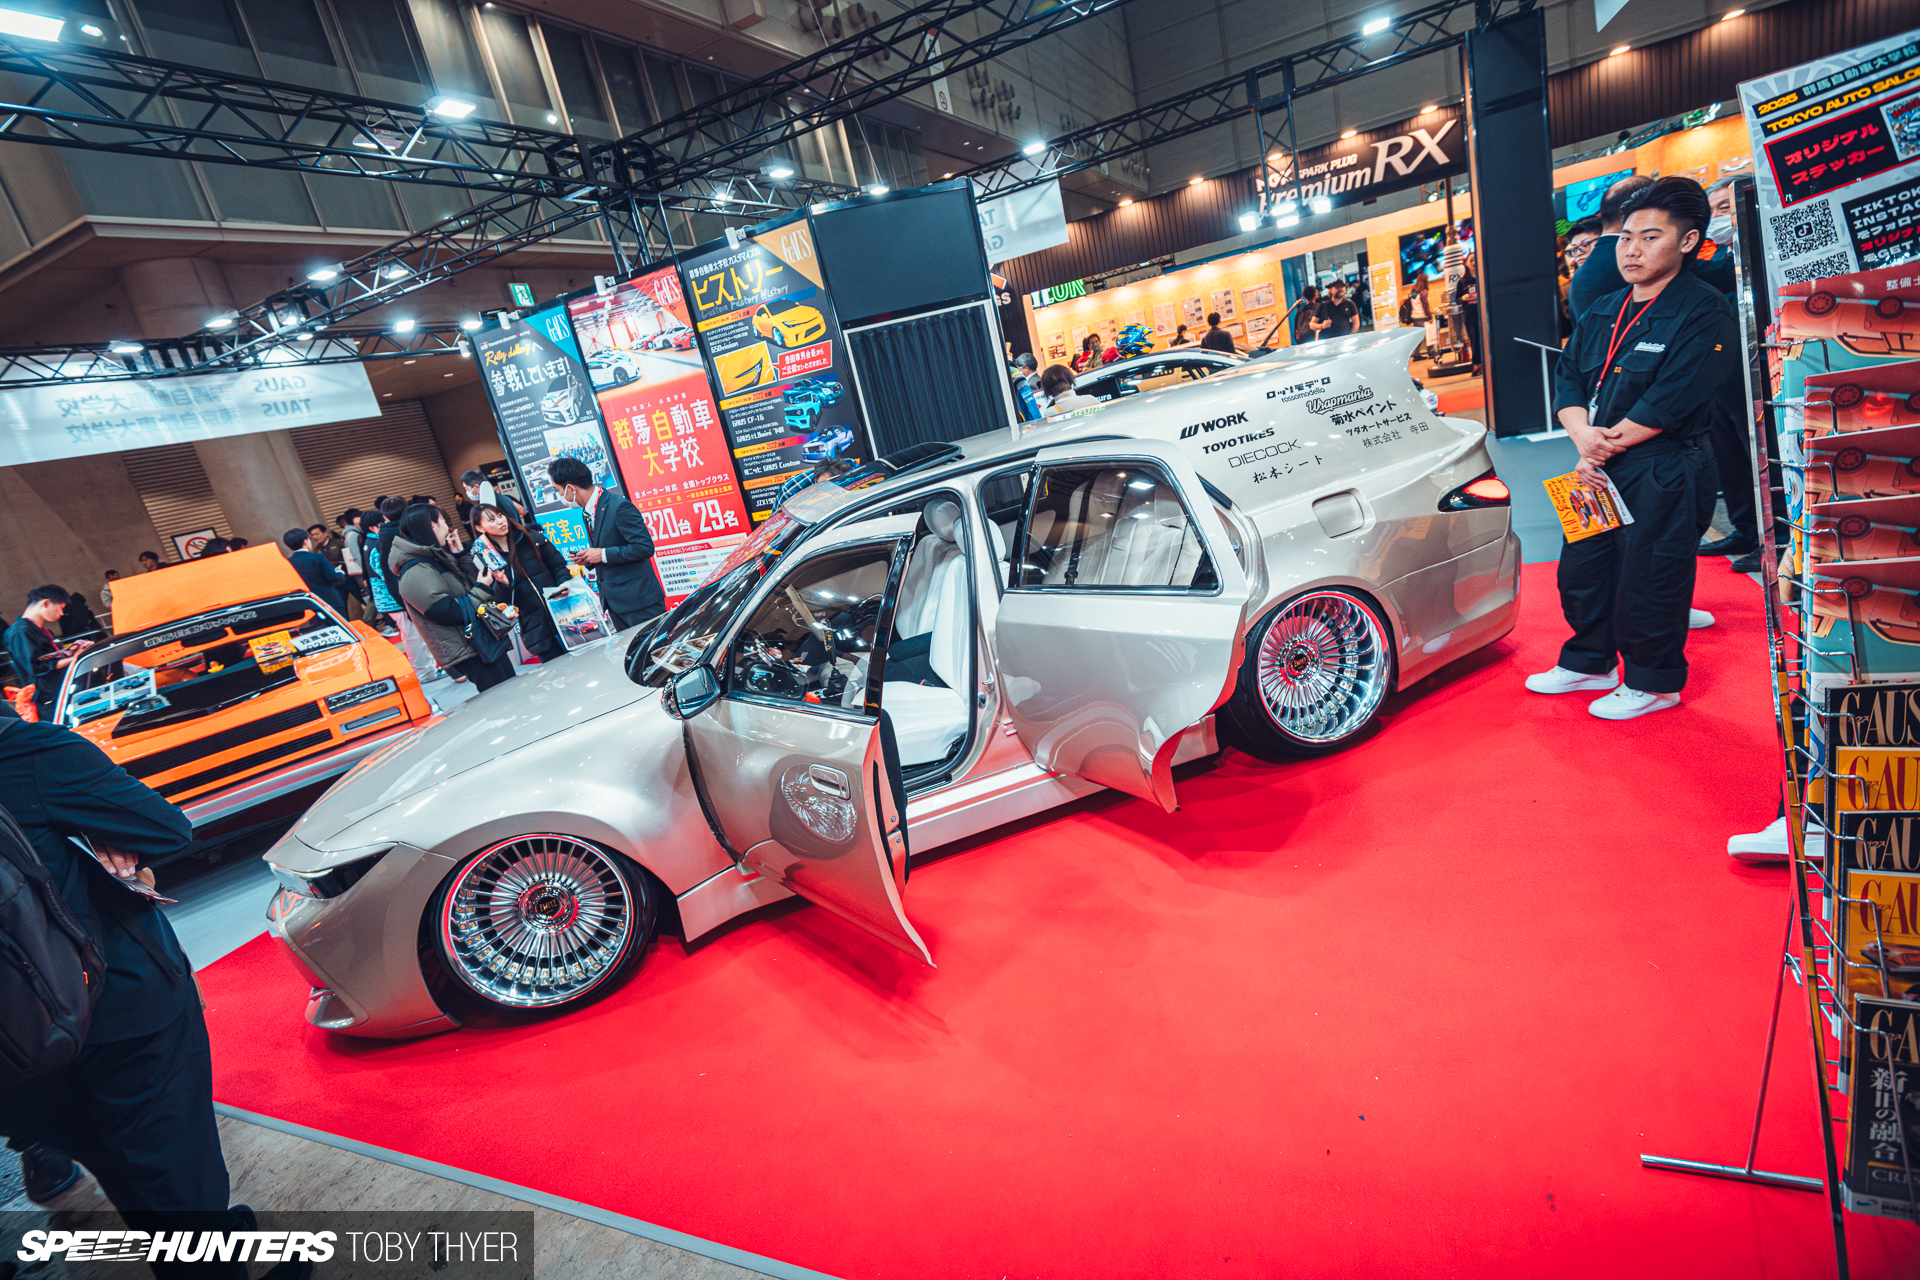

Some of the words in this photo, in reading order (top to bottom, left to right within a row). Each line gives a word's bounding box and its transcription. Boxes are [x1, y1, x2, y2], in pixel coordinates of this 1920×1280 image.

[1758, 93, 1799, 115] 2025
[1802, 44, 1919, 96] 群馬自動車大学校
[1767, 104, 1823, 132] TOKYO
[1825, 86, 1872, 112] AUTO
[1330, 153, 1358, 170] PLUG
[1371, 119, 1458, 184] RX
[1784, 123, 1880, 166] オリジナル
[1791, 145, 1886, 185] ステッカー
[781, 229, 811, 264] GAUS
[653, 274, 681, 306] GAUS
[692, 259, 783, 310] ヒストリー
[730, 294, 759, 310] Factory
[760, 285, 789, 299] History
[490, 357, 572, 397] 参戦しています!
[1305, 384, 1374, 415] Wrapmania
[1330, 400, 1397, 426] 菊水ペイント
[612, 399, 714, 450] 群馬自動車
[1200, 411, 1249, 433] WORK
[1362, 429, 1403, 448] 株式会社
[1409, 421, 1430, 436] 寺田
[642, 436, 704, 477] 大学校
[1202, 438, 1237, 454] TOYO
[1237, 427, 1275, 444] TIRES
[1228, 439, 1301, 468] DIECOCK
[634, 484, 678, 499] 全メーカー対応
[683, 473, 730, 489] 全国トップクラス
[1253, 454, 1323, 484] 松本シート
[693, 499, 739, 533] 29名
[1870, 1067, 1908, 1161] 新旧の融合
